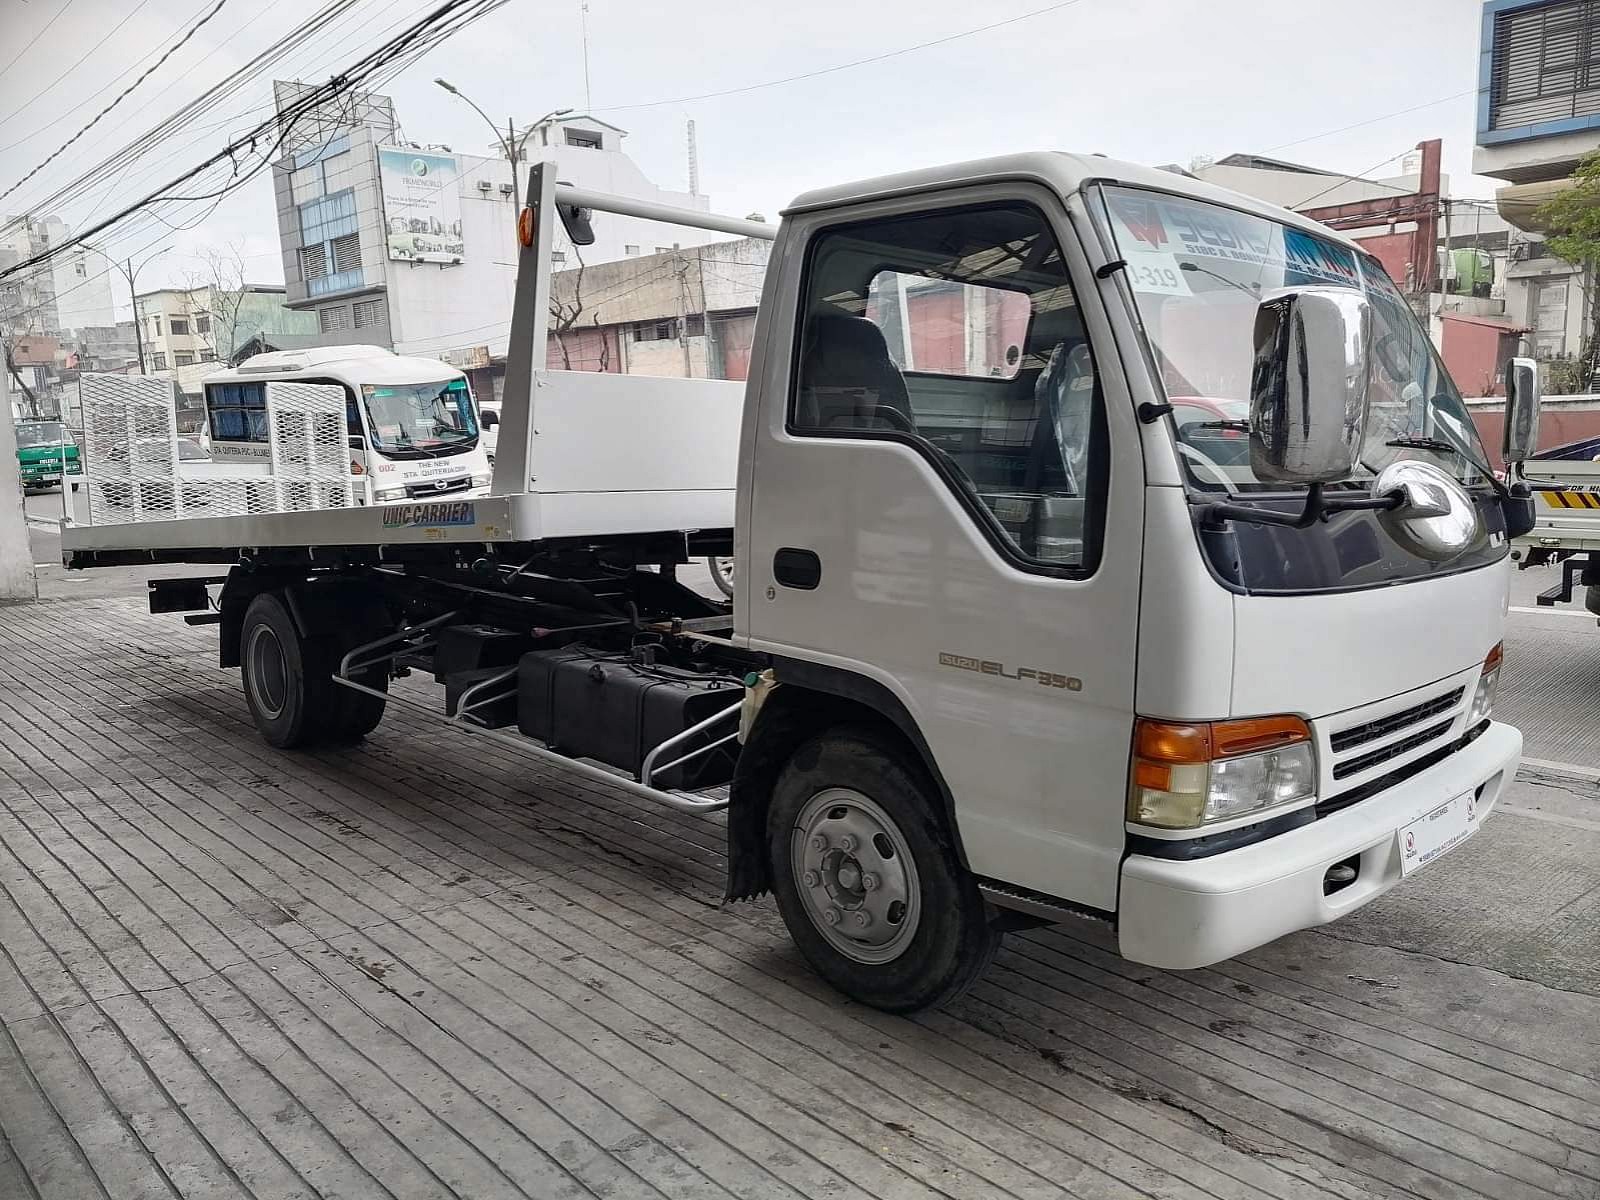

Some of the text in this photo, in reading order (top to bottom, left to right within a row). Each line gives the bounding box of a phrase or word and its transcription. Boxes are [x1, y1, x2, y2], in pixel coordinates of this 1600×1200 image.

[378, 463, 397, 473] 002
[417, 460, 450, 469] THE NEW
